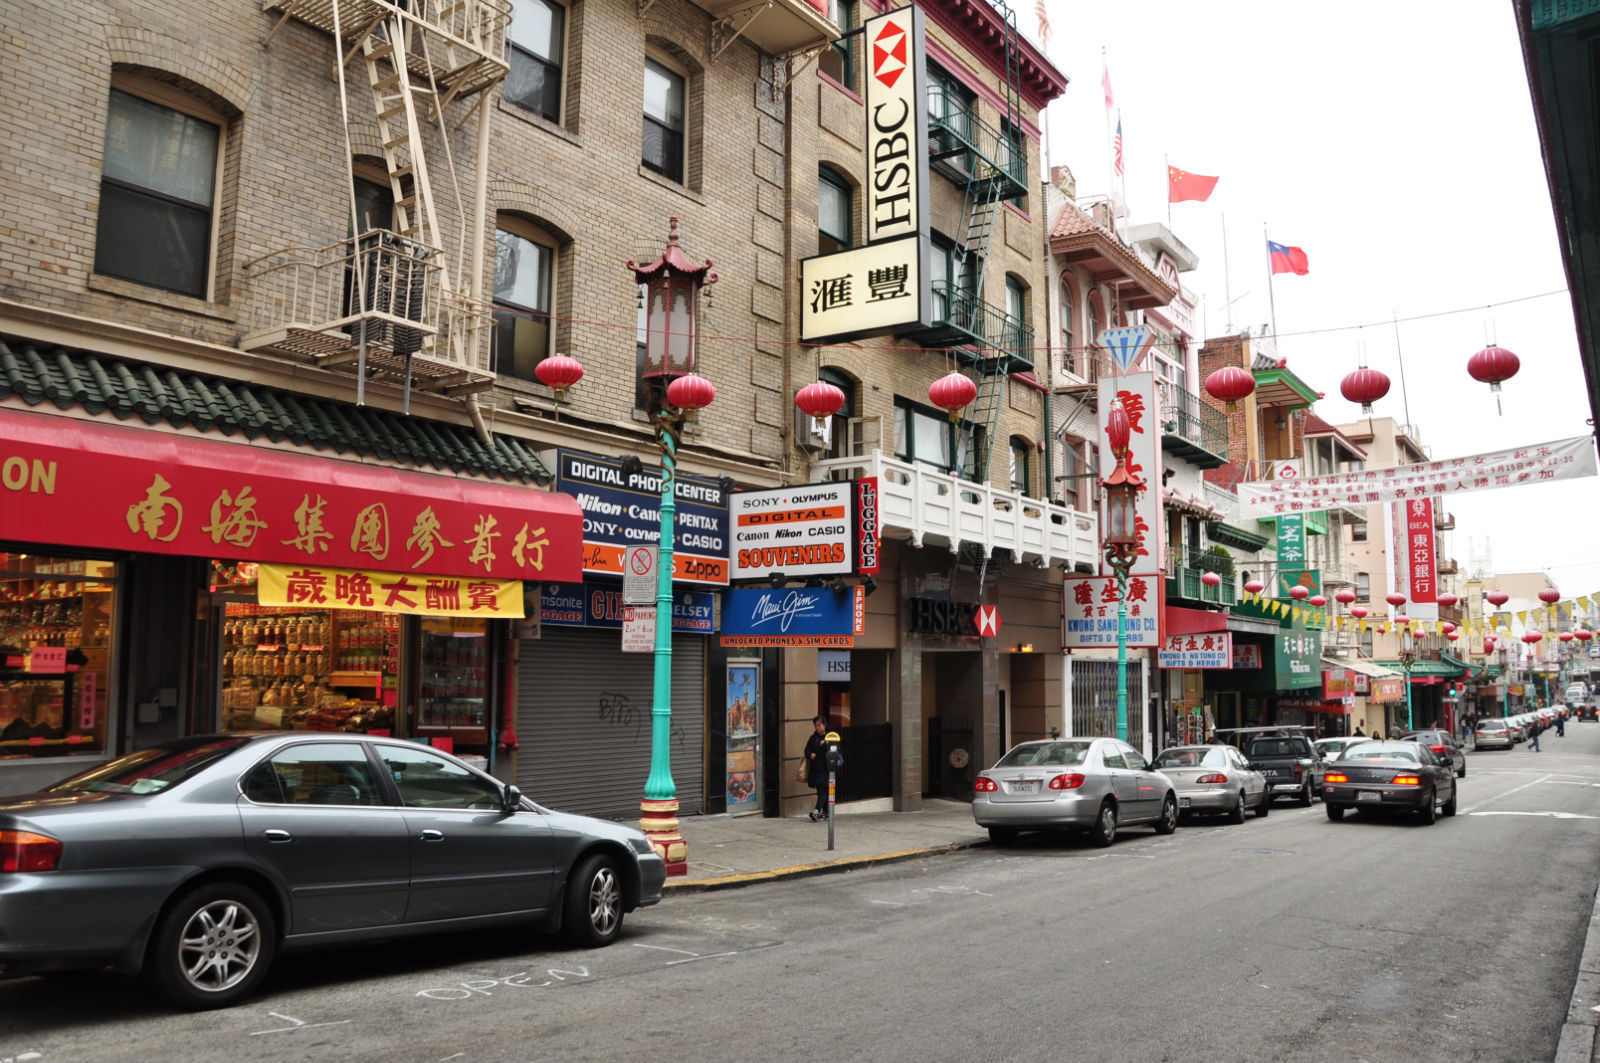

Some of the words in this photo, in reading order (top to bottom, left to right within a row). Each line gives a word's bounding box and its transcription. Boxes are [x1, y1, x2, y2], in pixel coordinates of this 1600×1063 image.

[873, 97, 911, 233] HSBC
[2, 456, 57, 495] ON
[571, 461, 625, 486] DIGITAL
[629, 474, 662, 493] PHOT
[675, 482, 720, 504] CENTER
[577, 492, 622, 516] Nikon
[628, 504, 662, 522] Can
[679, 512, 719, 531] PENTAX
[743, 497, 780, 508] SONY
[791, 492, 838, 504] OLYMPUS
[750, 509, 832, 524] DIGITAL
[862, 483, 876, 568] LUGGAGE
[1409, 521, 1429, 530] BEA
[583, 519, 619, 535] ONY
[624, 527, 676, 545] OLYMPS
[682, 533, 723, 550] CASIO
[736, 530, 769, 542] Canon
[775, 529, 802, 539] Nikon
[808, 525, 845, 537] CASIO
[738, 542, 845, 568] SOUVENIRS
[1413, 533, 1430, 593] 東亞銀行
[286, 568, 501, 612] 歲晚大酬賓
[625, 609, 634, 620] NO
[634, 611, 656, 620] PARKING
[674, 605, 711, 617] ELSEY
[1068, 619, 1094, 632] KWONG
[1097, 618, 1118, 631] SANG
[1125, 618, 1141, 631] UNG
[1080, 634, 1103, 643] GIFTS
[1115, 633, 1143, 642] HRBS
[725, 636, 763, 645] UNLOCKED
[765, 636, 795, 645] PHONES
[806, 636, 820, 645] SIM
[823, 636, 850, 645] CARDS
[415, 966, 589, 1000] OPEN
